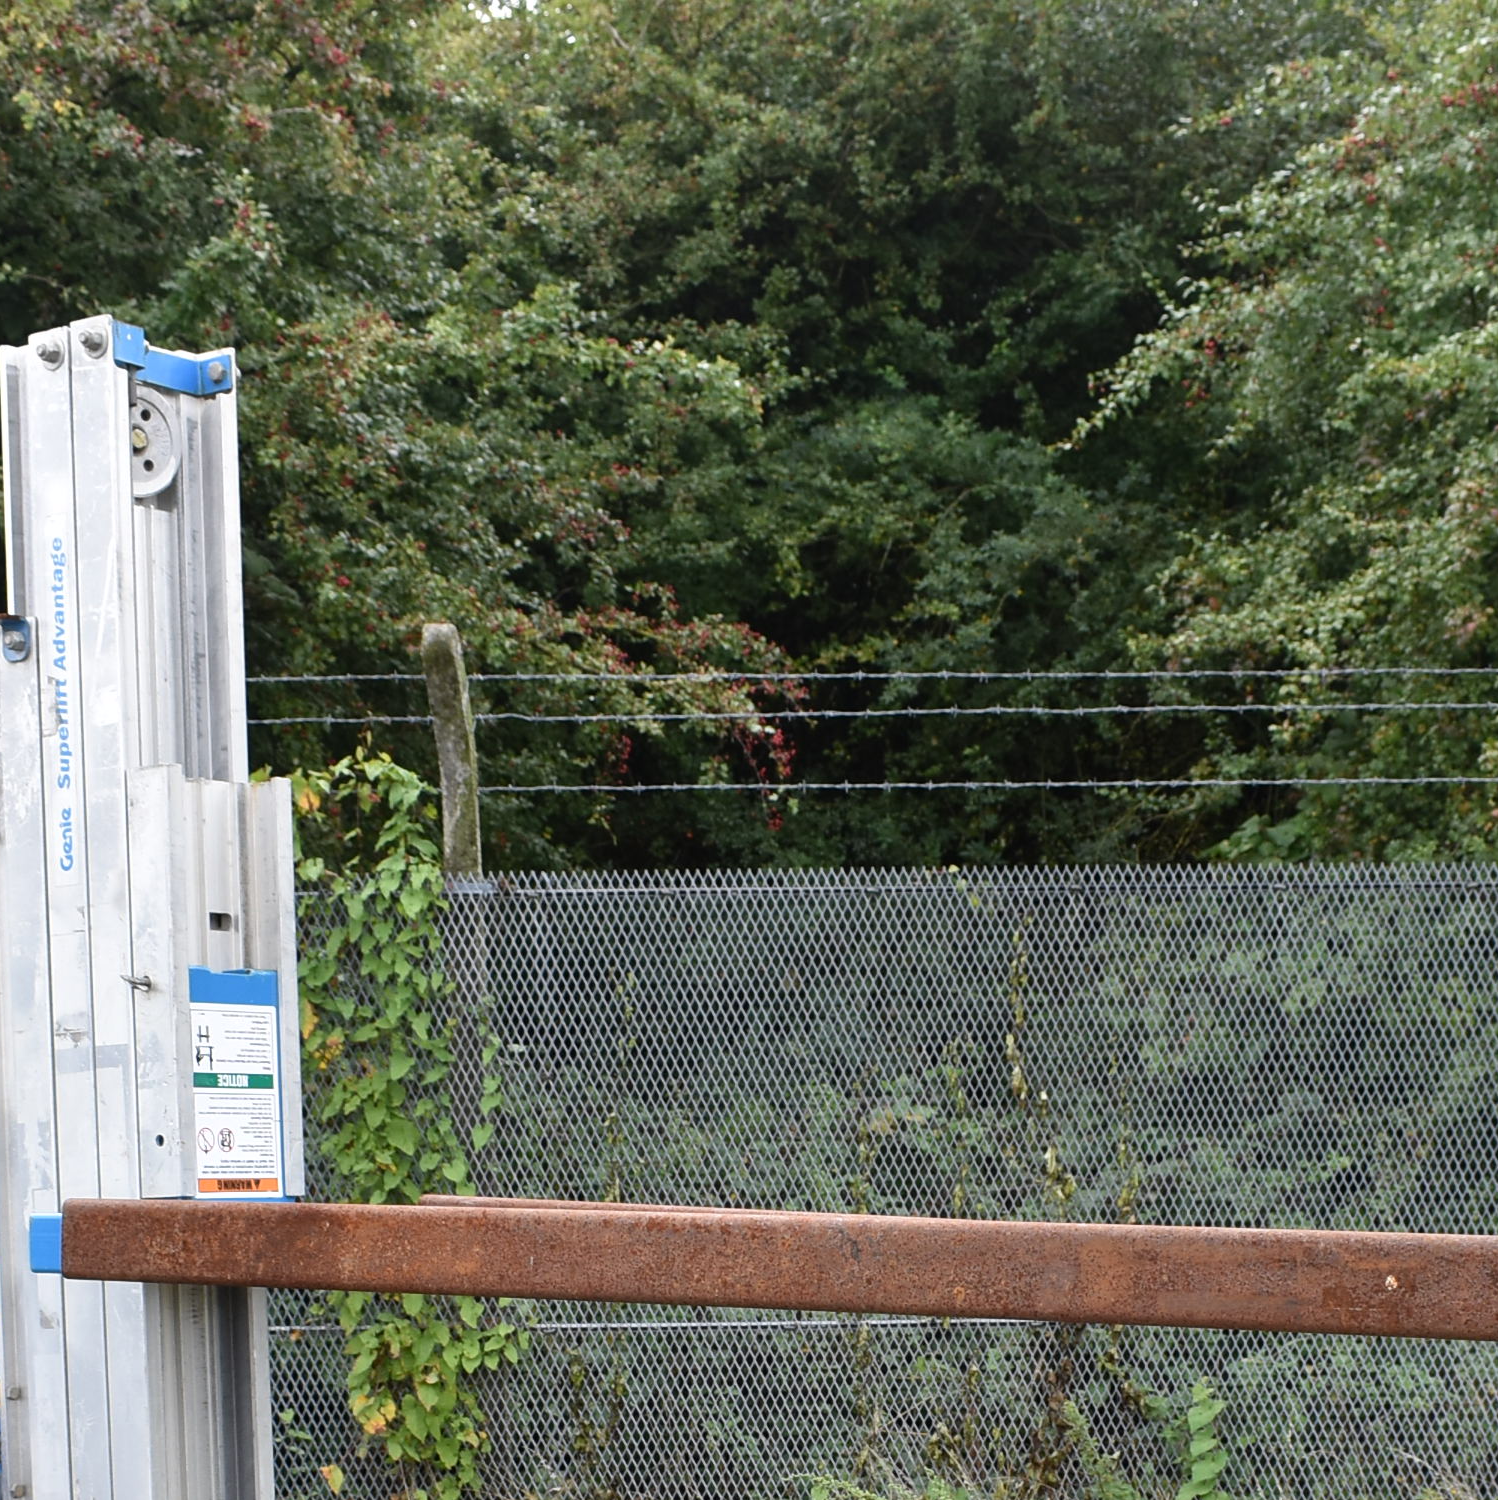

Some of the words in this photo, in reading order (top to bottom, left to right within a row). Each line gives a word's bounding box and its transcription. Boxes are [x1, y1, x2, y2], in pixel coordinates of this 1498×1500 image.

[51, 537, 67, 671] Advantage
[59, 807, 73, 871] Genie
[217, 1074, 249, 1088] NOTICE
[217, 1179, 253, 1191] WARNING
